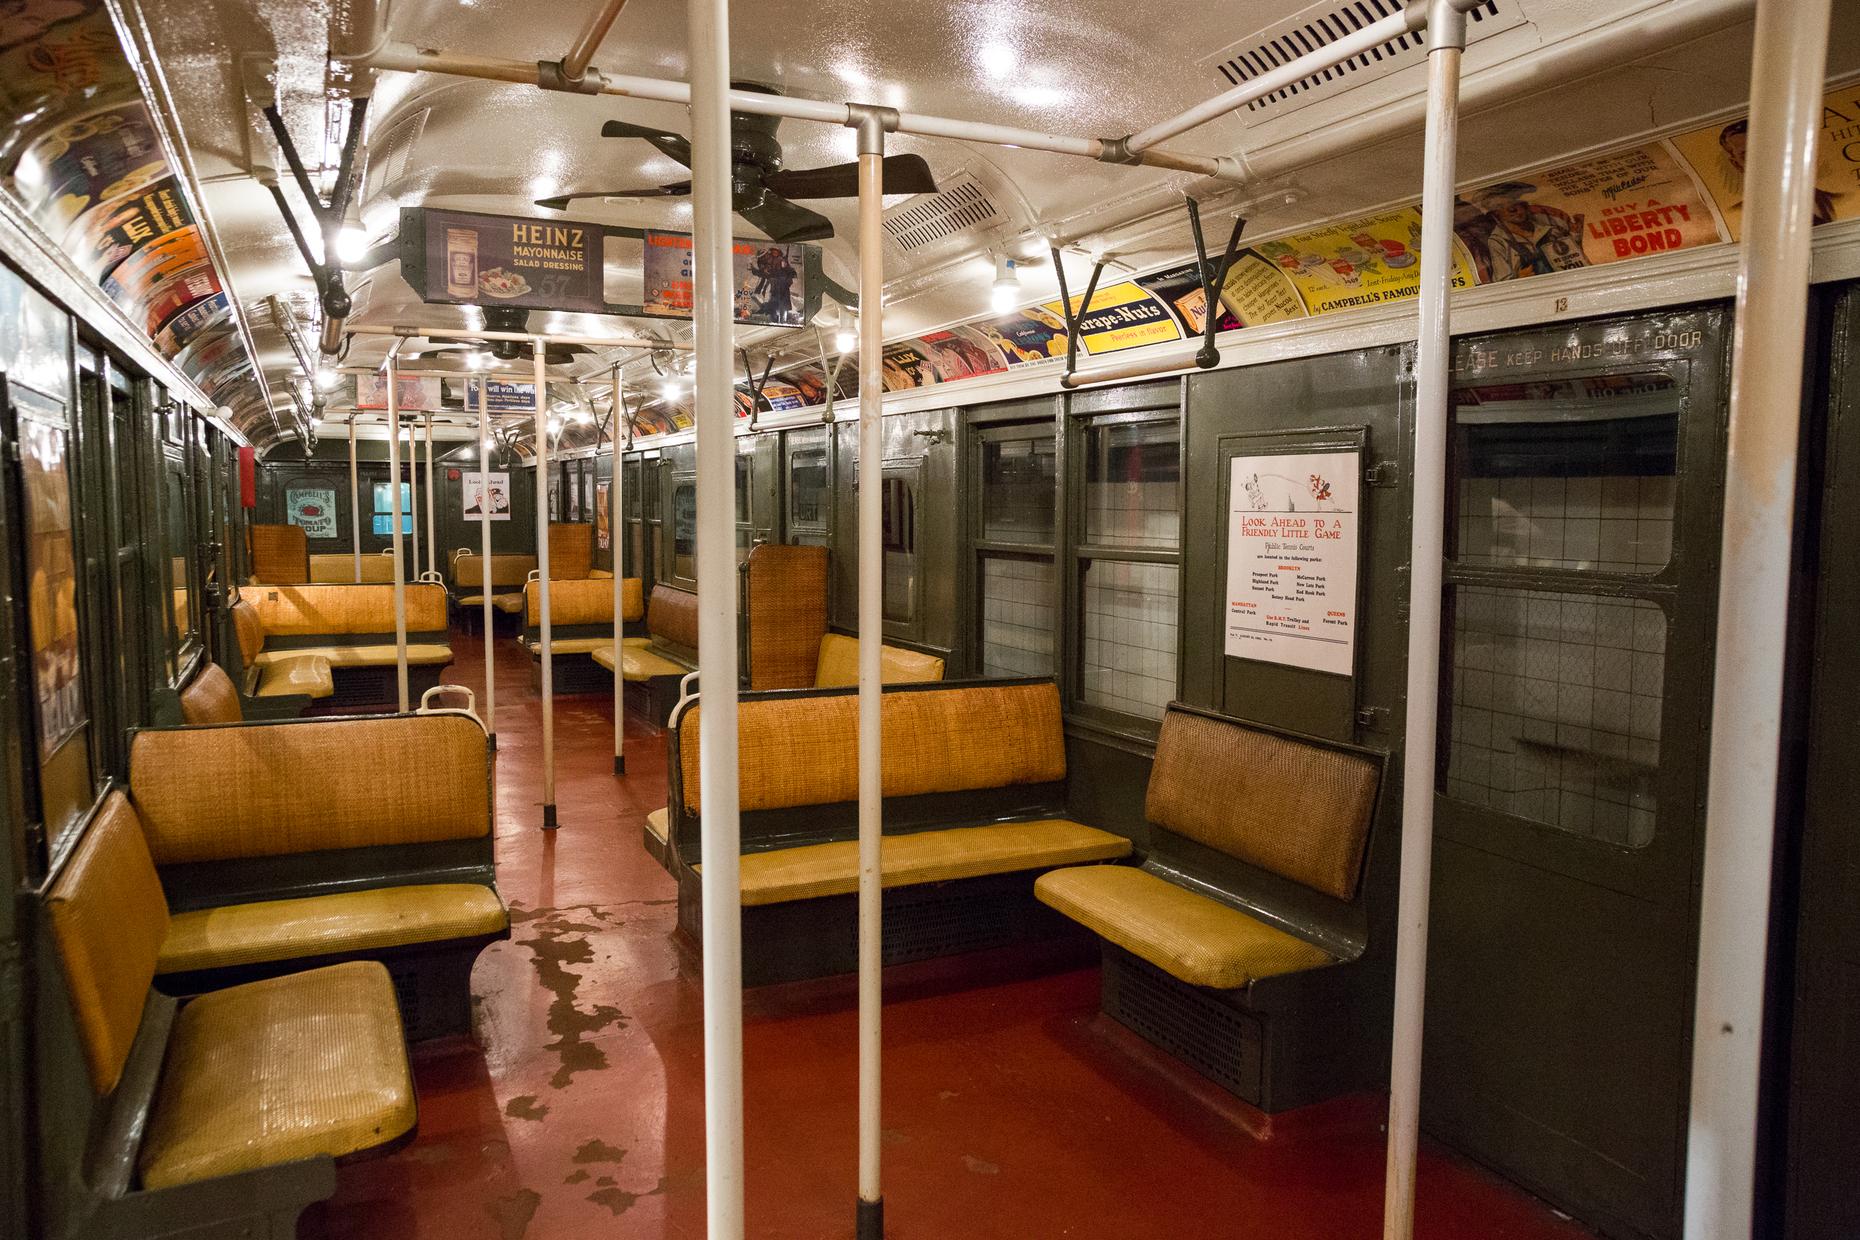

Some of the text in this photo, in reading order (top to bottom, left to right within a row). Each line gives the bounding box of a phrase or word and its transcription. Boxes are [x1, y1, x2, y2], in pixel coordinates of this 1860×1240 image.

[1600, 199, 1662, 217] BUY A
[1310, 227, 1339, 239] Strictly
[1336, 217, 1377, 232] Vegetable
[1587, 204, 1691, 239] LIBERTY
[122, 216, 153, 244] LUX
[513, 223, 584, 247] HEINZ
[1612, 228, 1682, 258] BOND
[513, 246, 583, 261] MAYONNAISE
[514, 259, 584, 271] SALAD DRESSING
[539, 274, 571, 297] 57
[1313, 284, 1421, 315] by CAMPBELL'S FAMOU
[1283, 304, 1299, 316] Best
[1110, 333, 1137, 342] Peerless
[1146, 326, 1167, 335] flavor
[893, 352, 920, 364] LUX
[1449, 331, 1702, 373] EASE KEEP HANDS OFF DOOR
[488, 385, 500, 393] will
[500, 385, 513, 393] win
[293, 515, 331, 526] TOMATO
[1242, 515, 1342, 529] LOOK AHEAD TO A
[1242, 526, 1341, 539] FRIENDLY LITTLE GAME
[1265, 542, 1280, 554] Public
[1299, 543, 1314, 551] Courts
